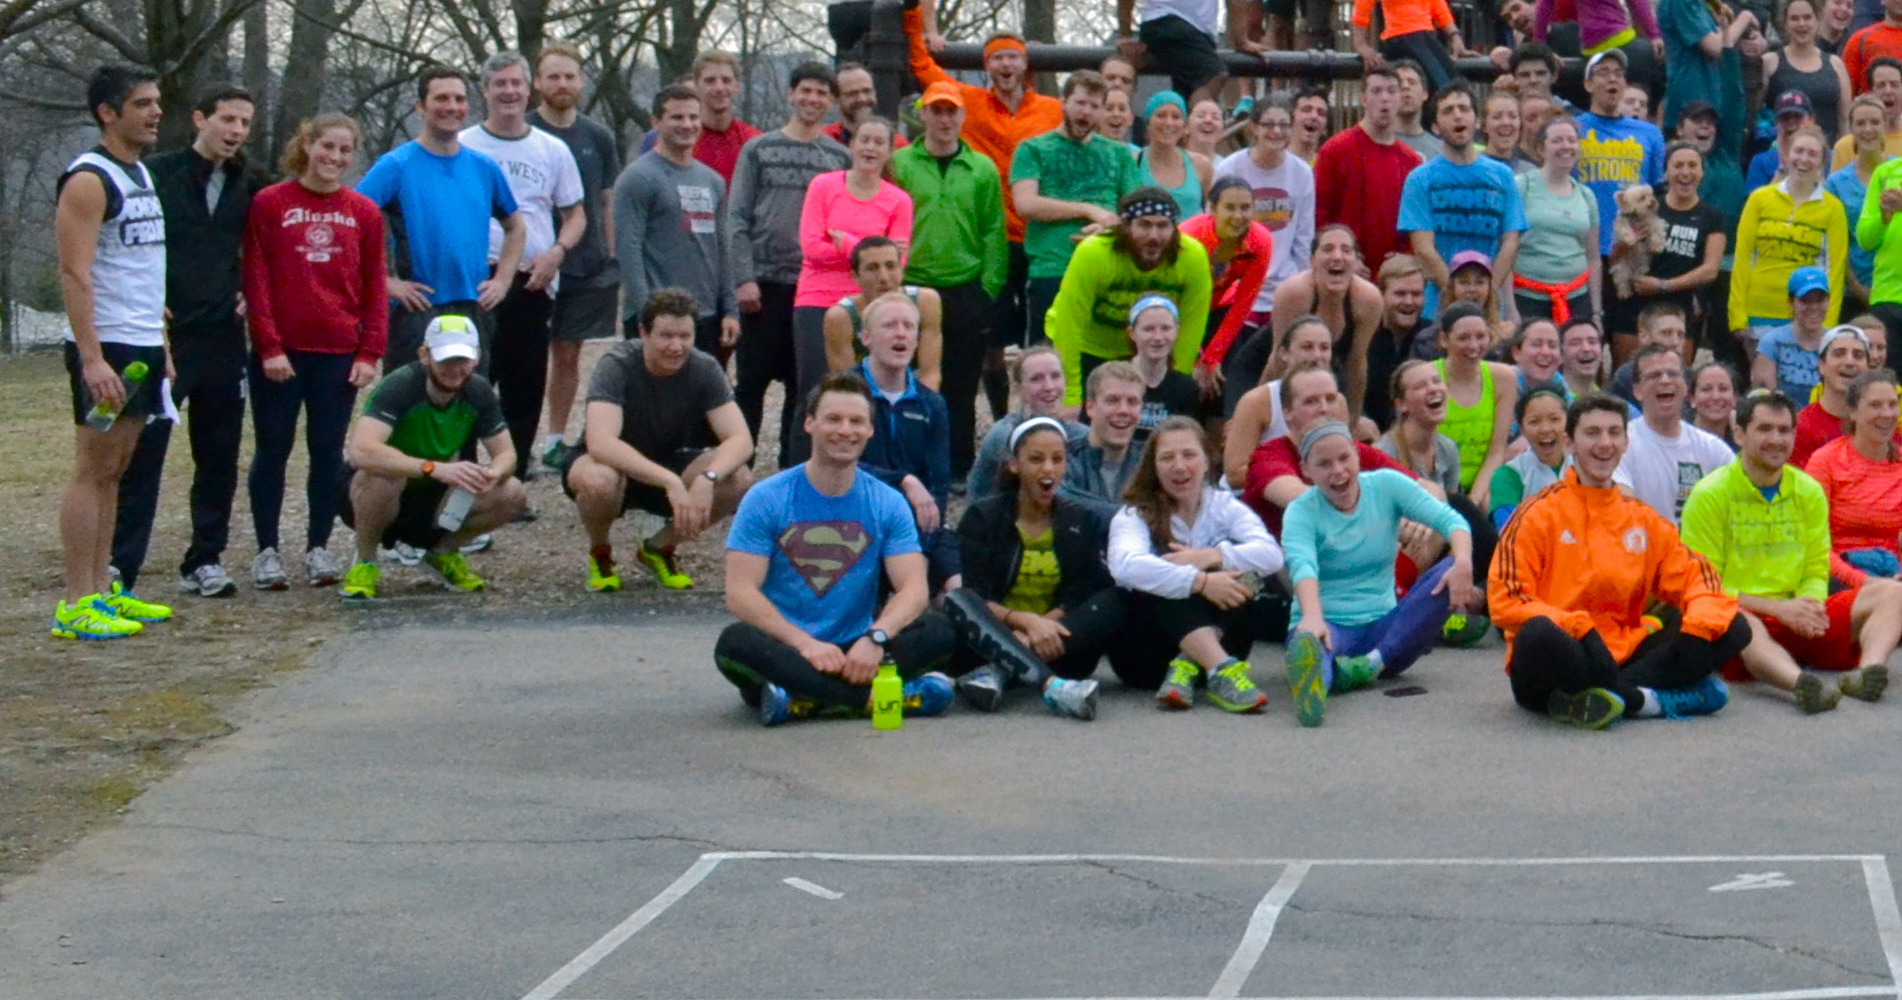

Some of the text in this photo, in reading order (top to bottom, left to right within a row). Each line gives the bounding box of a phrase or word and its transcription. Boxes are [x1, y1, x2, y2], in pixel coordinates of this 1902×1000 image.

[507, 159, 546, 190] WEST
[1578, 158, 1641, 182] STRONG
[1670, 224, 1699, 242] RUN
